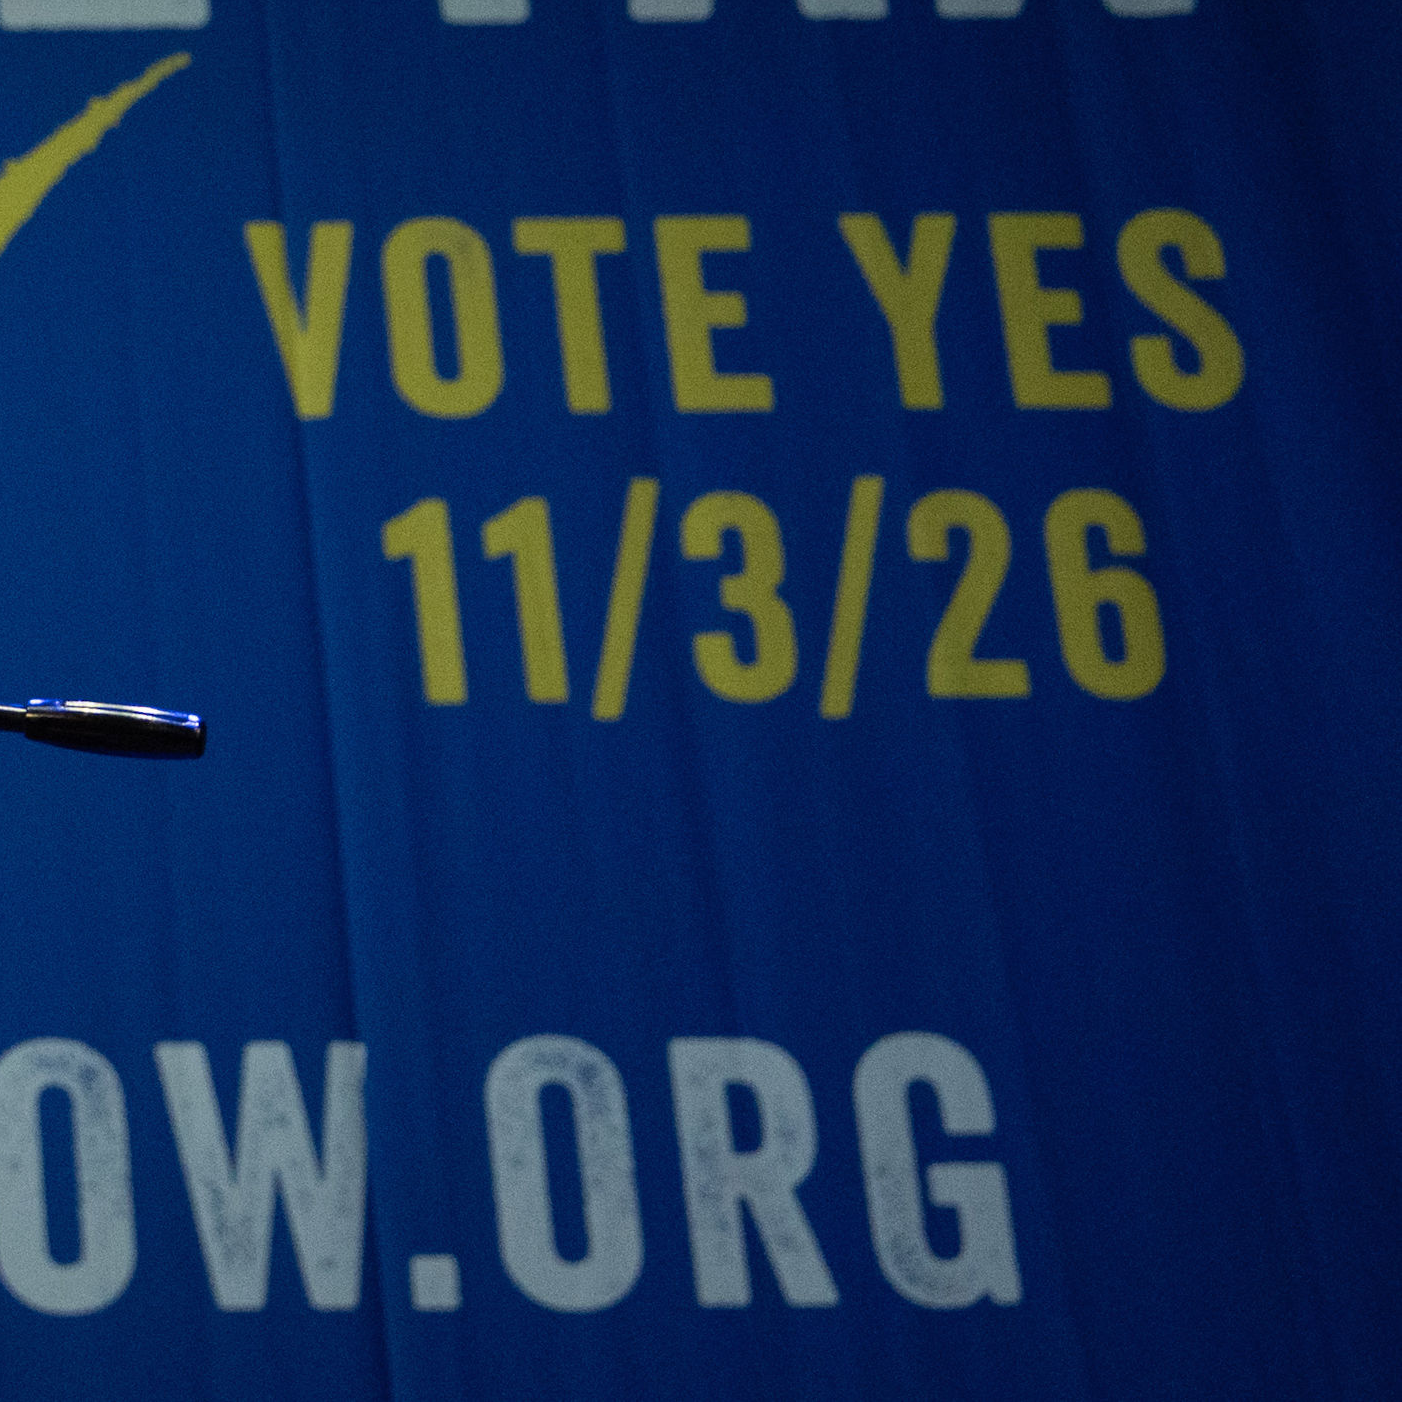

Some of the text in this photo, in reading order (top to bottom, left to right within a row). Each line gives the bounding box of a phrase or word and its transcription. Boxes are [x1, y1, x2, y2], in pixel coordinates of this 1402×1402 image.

[244, 208, 1244, 420] VOTE YES
[382, 476, 1166, 720] 11/3/26
